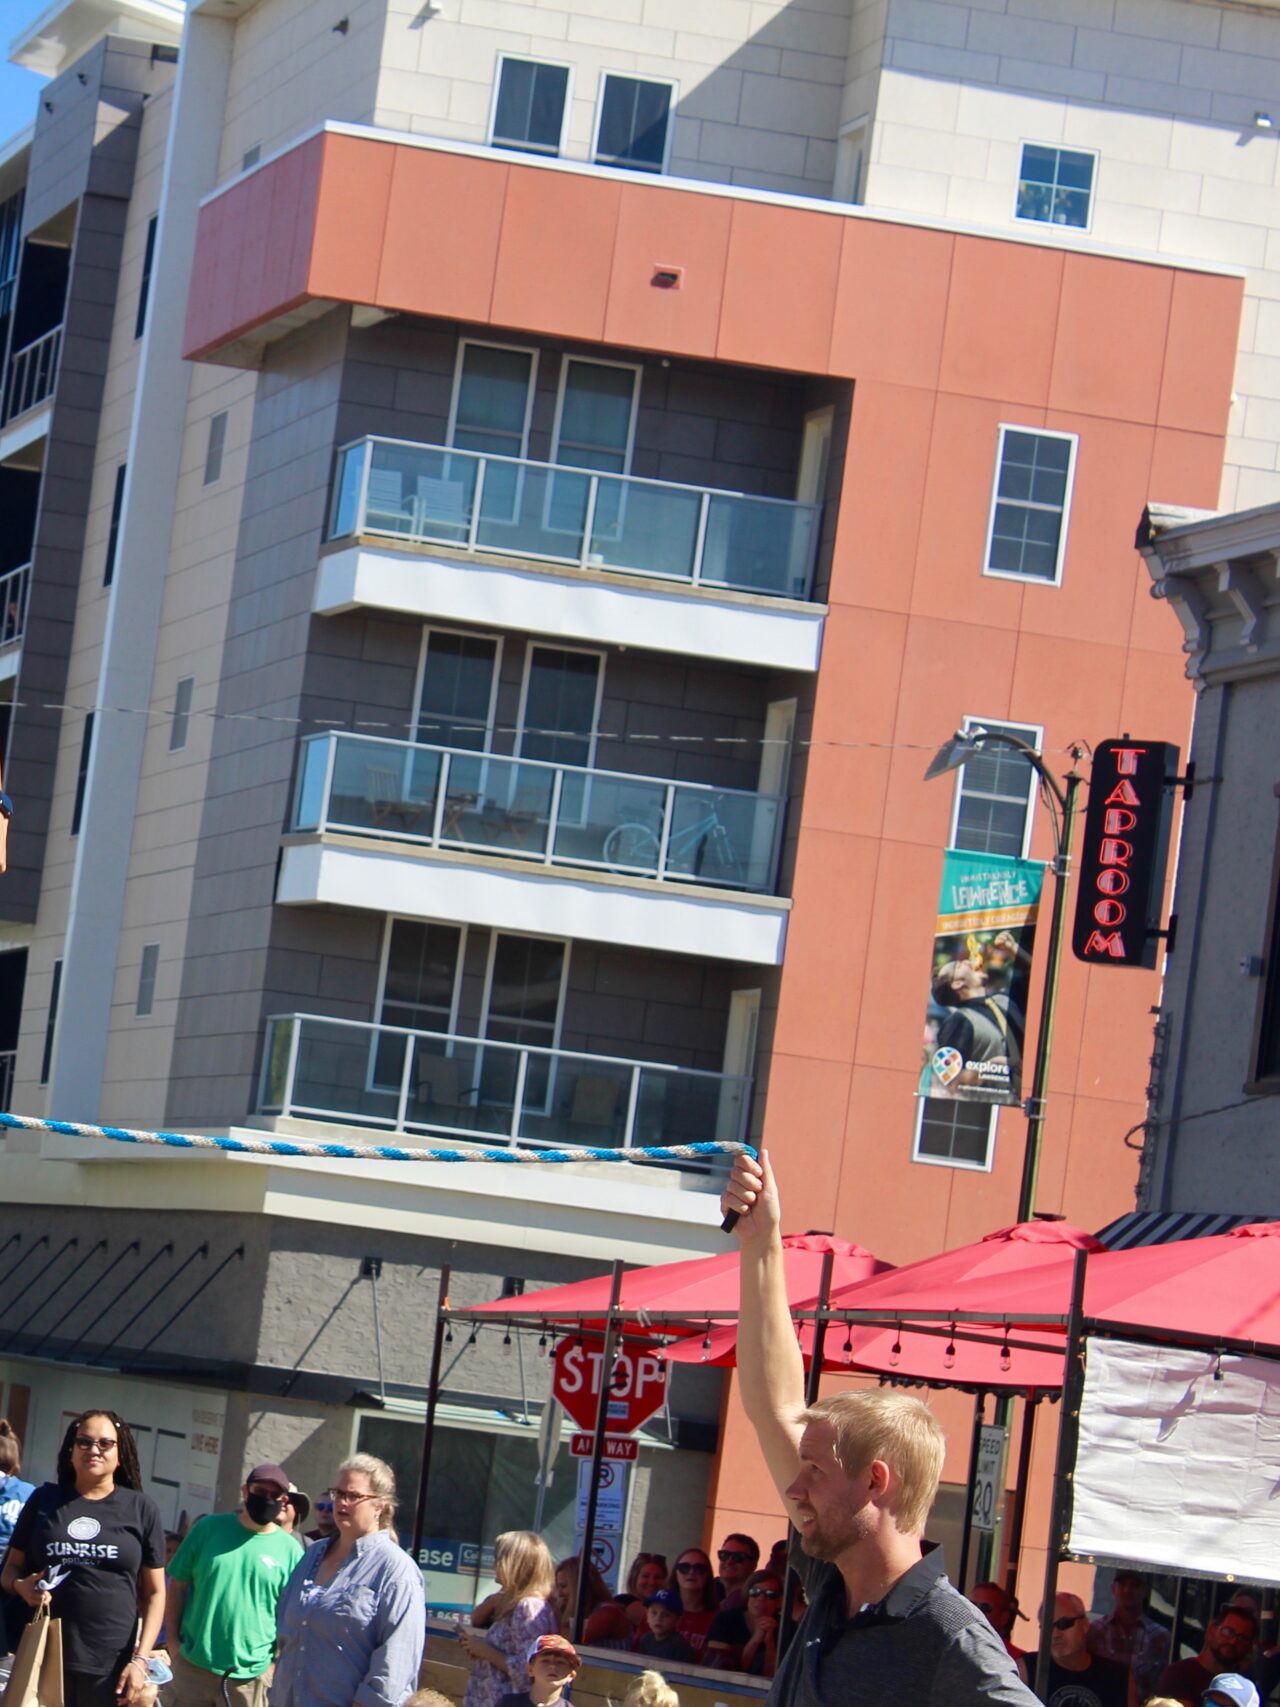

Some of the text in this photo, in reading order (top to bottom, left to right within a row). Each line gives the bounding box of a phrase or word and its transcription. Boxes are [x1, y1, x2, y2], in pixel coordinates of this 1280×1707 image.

[1084, 748, 1147, 958] TAPROOM
[965, 1060, 1010, 1075] explore
[560, 1347, 661, 1399] STOP
[606, 1441, 632, 1457] WAY
[980, 1438, 1000, 1455] PEED
[46, 1541, 119, 1559] SUNRISE
[407, 1547, 454, 1567] ase
